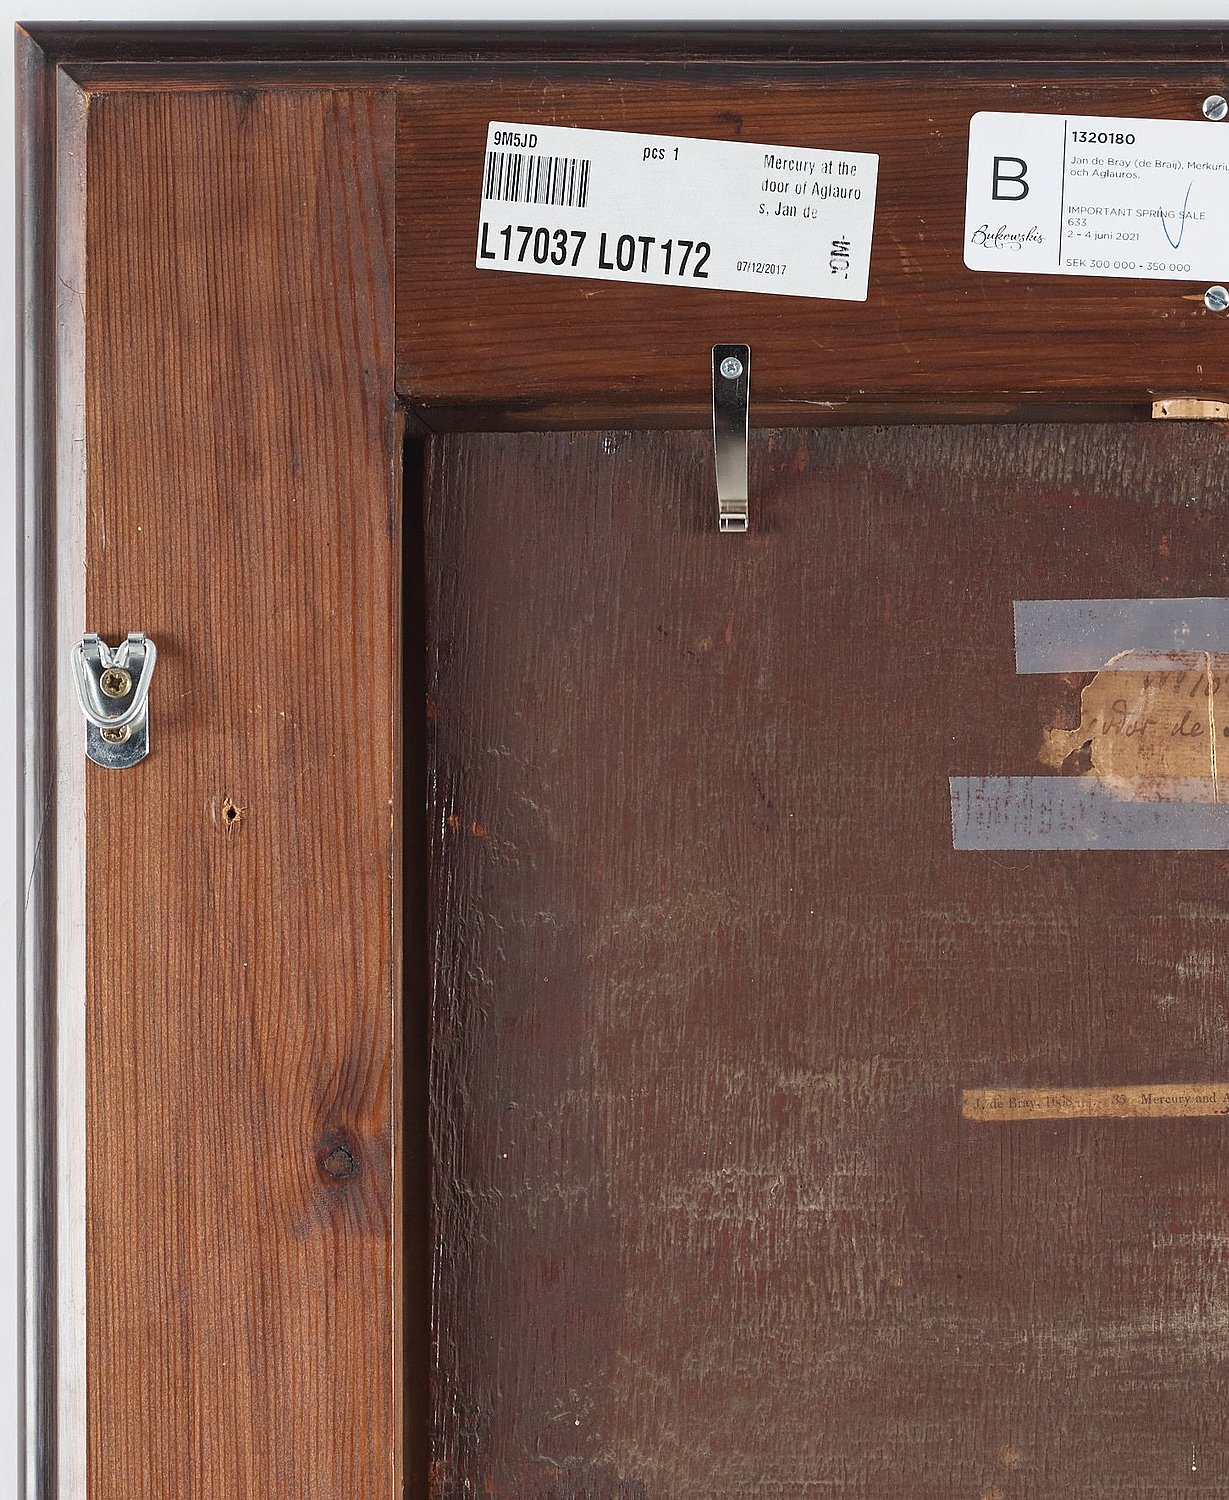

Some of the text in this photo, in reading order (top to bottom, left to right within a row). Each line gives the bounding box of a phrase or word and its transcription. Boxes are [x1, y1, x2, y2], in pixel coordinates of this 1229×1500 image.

[493, 131, 538, 149] 9M5JD
[1072, 131, 1136, 145] 1320180
[643, 146, 680, 161] pcs 1
[764, 154, 857, 176] Mercury at the
[1070, 156, 1089, 165] Jan
[1091, 157, 1104, 166] de
[1107, 157, 1131, 168] Bray
[1134, 158, 1151, 168] (de
[991, 156, 1030, 201] B
[1069, 169, 1089, 177] och
[762, 178, 861, 199] door of Aglauro
[775, 202, 797, 217] Jan
[803, 205, 818, 219] de
[1068, 206, 1206, 220] IMPORTANT SPRING SALE
[1067, 218, 1087, 227] 633
[970, 224, 1046, 251] Bukowskis
[1067, 230, 1074, 238] 2
[1085, 231, 1092, 239] 4
[1094, 231, 1113, 241] juni
[1115, 232, 1140, 241] 2021
[480, 222, 587, 267] L17037
[736, 260, 787, 275] 07/12/2017
[1066, 258, 1086, 268] SEK
[1089, 259, 1110, 269] 300
[1113, 260, 1136, 270] 000
[1146, 262, 1166, 271] 350
[1168, 263, 1191, 272] 000
[973, 1099, 986, 1110] J.
[990, 1097, 1004, 1109] de
[1141, 1093, 1190, 1108] Mercury
[1195, 1091, 1217, 1104] and
